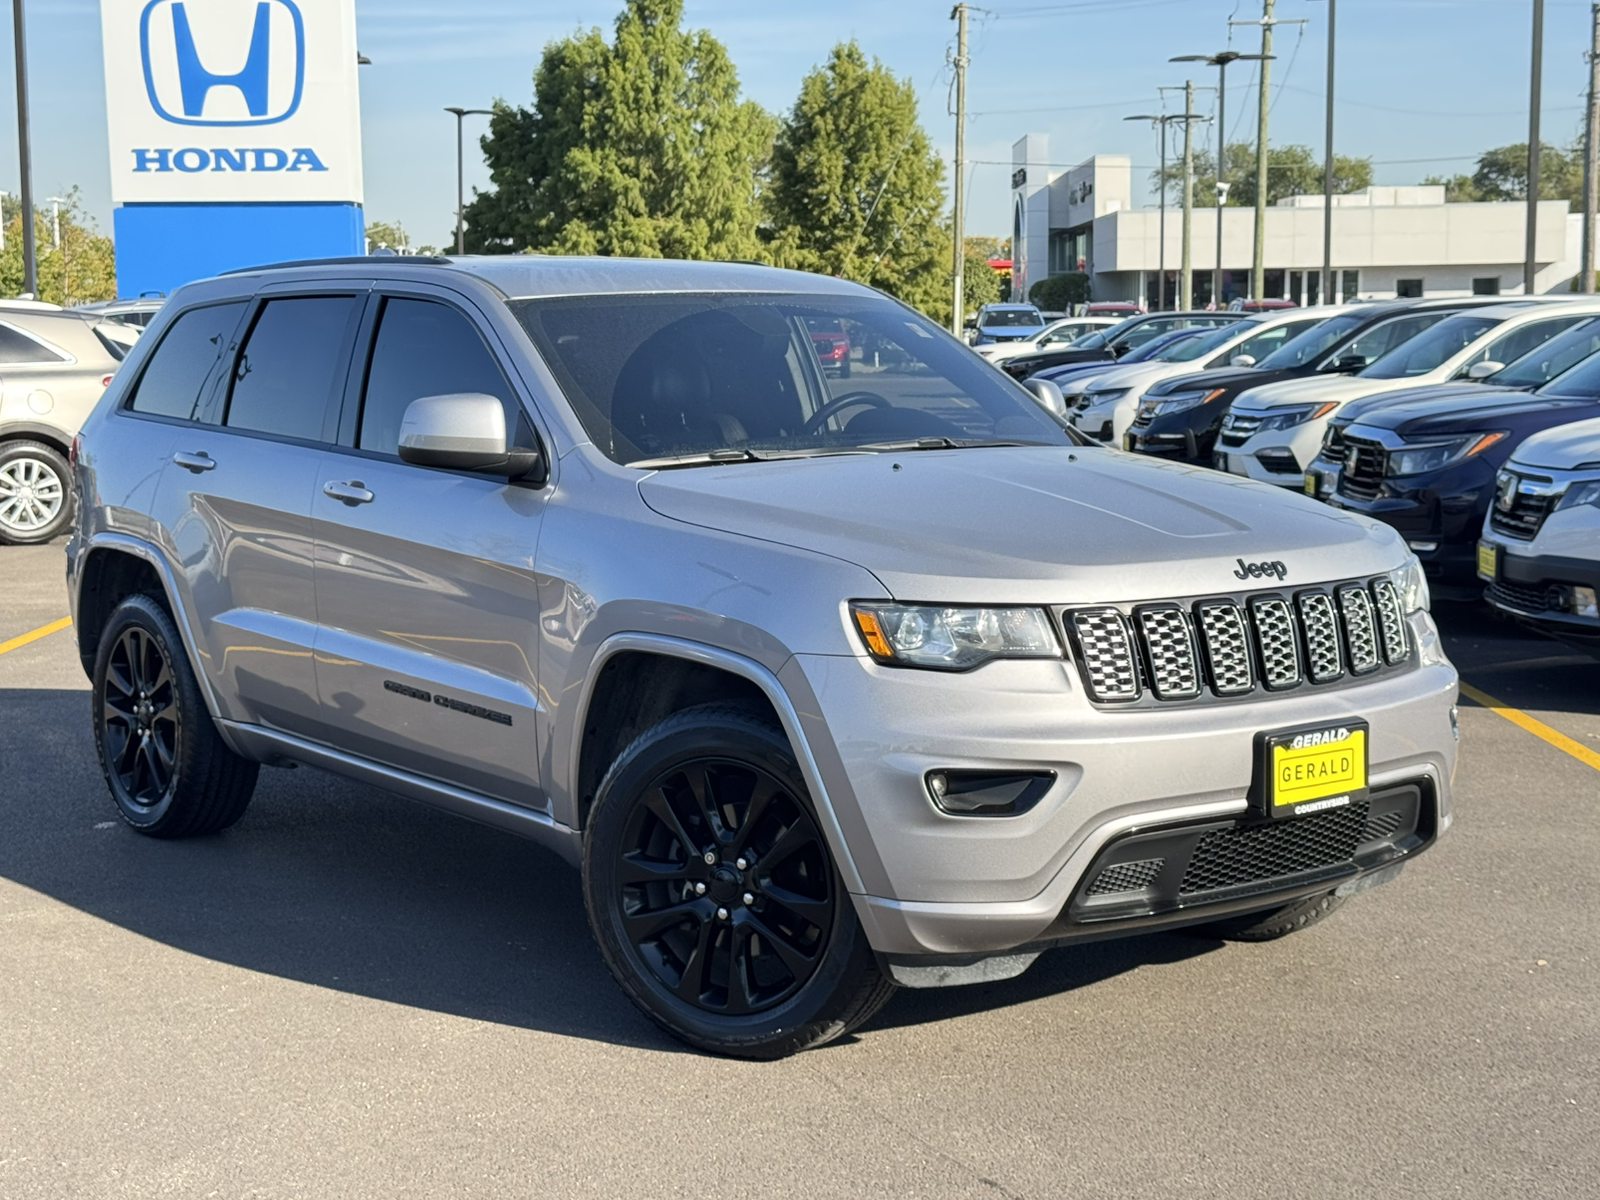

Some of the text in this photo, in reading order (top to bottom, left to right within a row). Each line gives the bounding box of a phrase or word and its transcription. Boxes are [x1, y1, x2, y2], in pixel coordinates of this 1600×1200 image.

[131, 147, 329, 173] HONDA
[1233, 558, 1288, 581] Jeep
[1292, 727, 1350, 749] GERALD
[1282, 757, 1350, 782] GERALD
